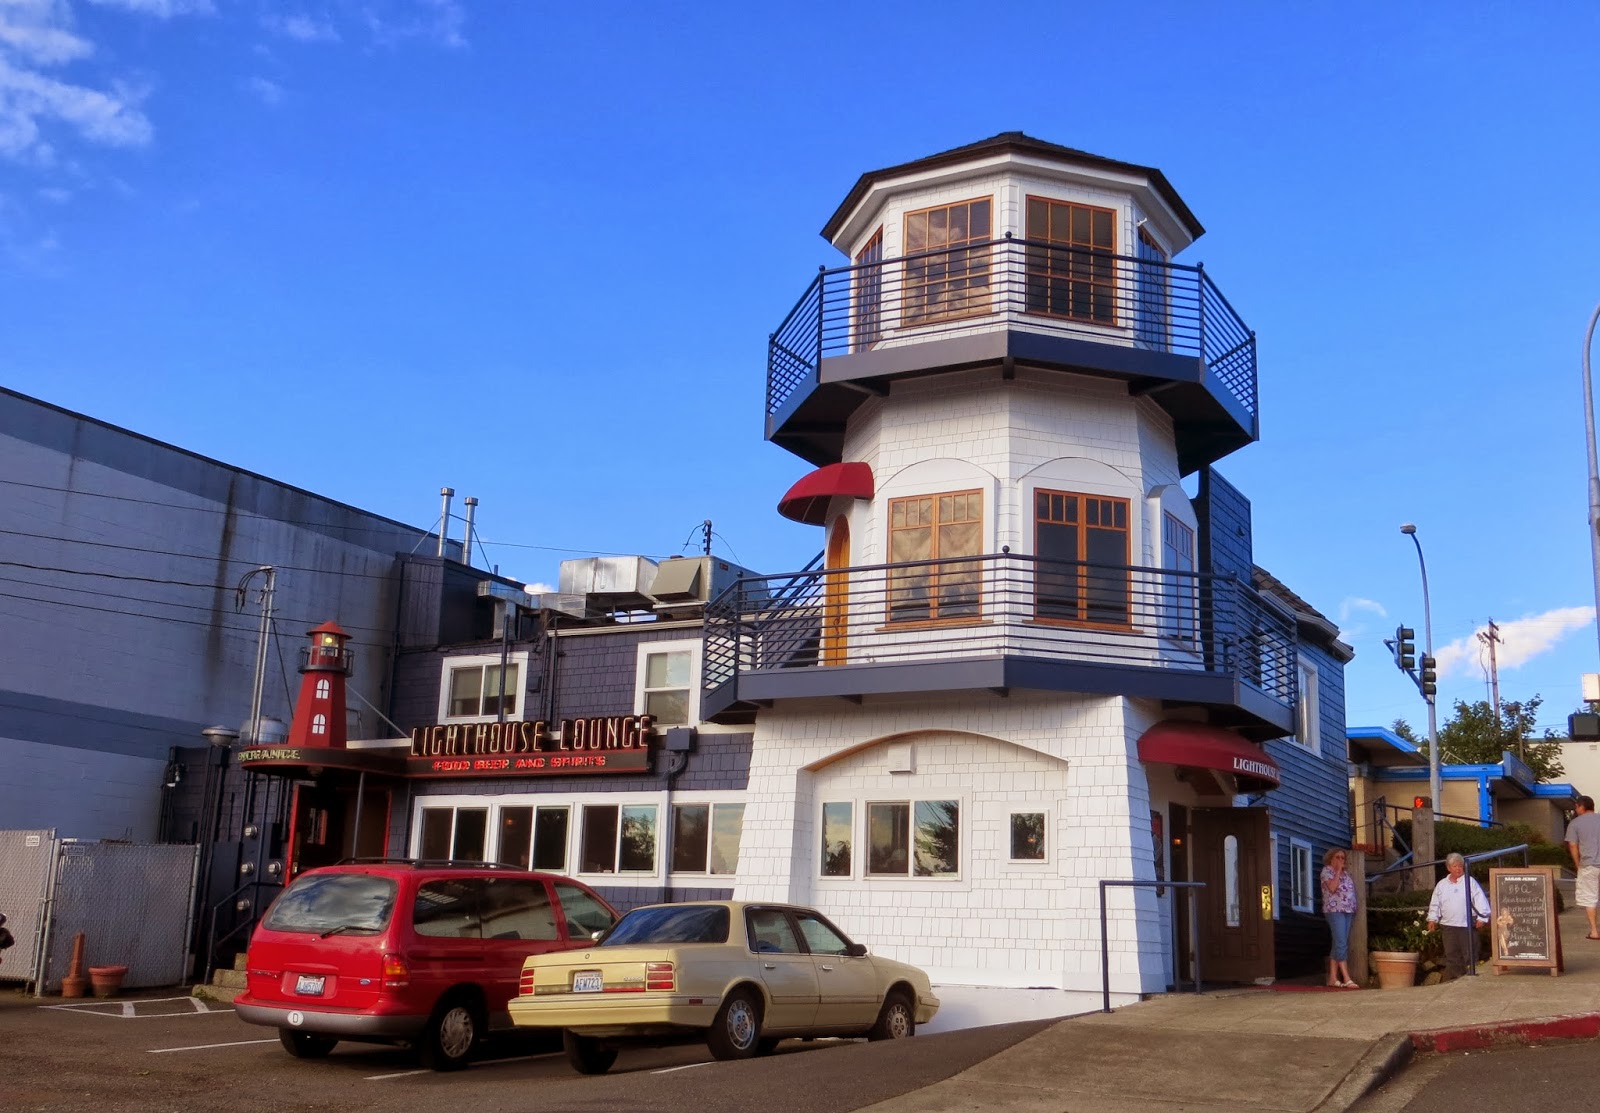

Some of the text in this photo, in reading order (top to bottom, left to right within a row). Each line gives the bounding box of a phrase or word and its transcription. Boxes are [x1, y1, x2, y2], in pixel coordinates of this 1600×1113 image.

[410, 715, 652, 756] LIGHTHOUSE LOUNGE
[432, 756, 606, 771] FOOD BEER AND SPIRITS
